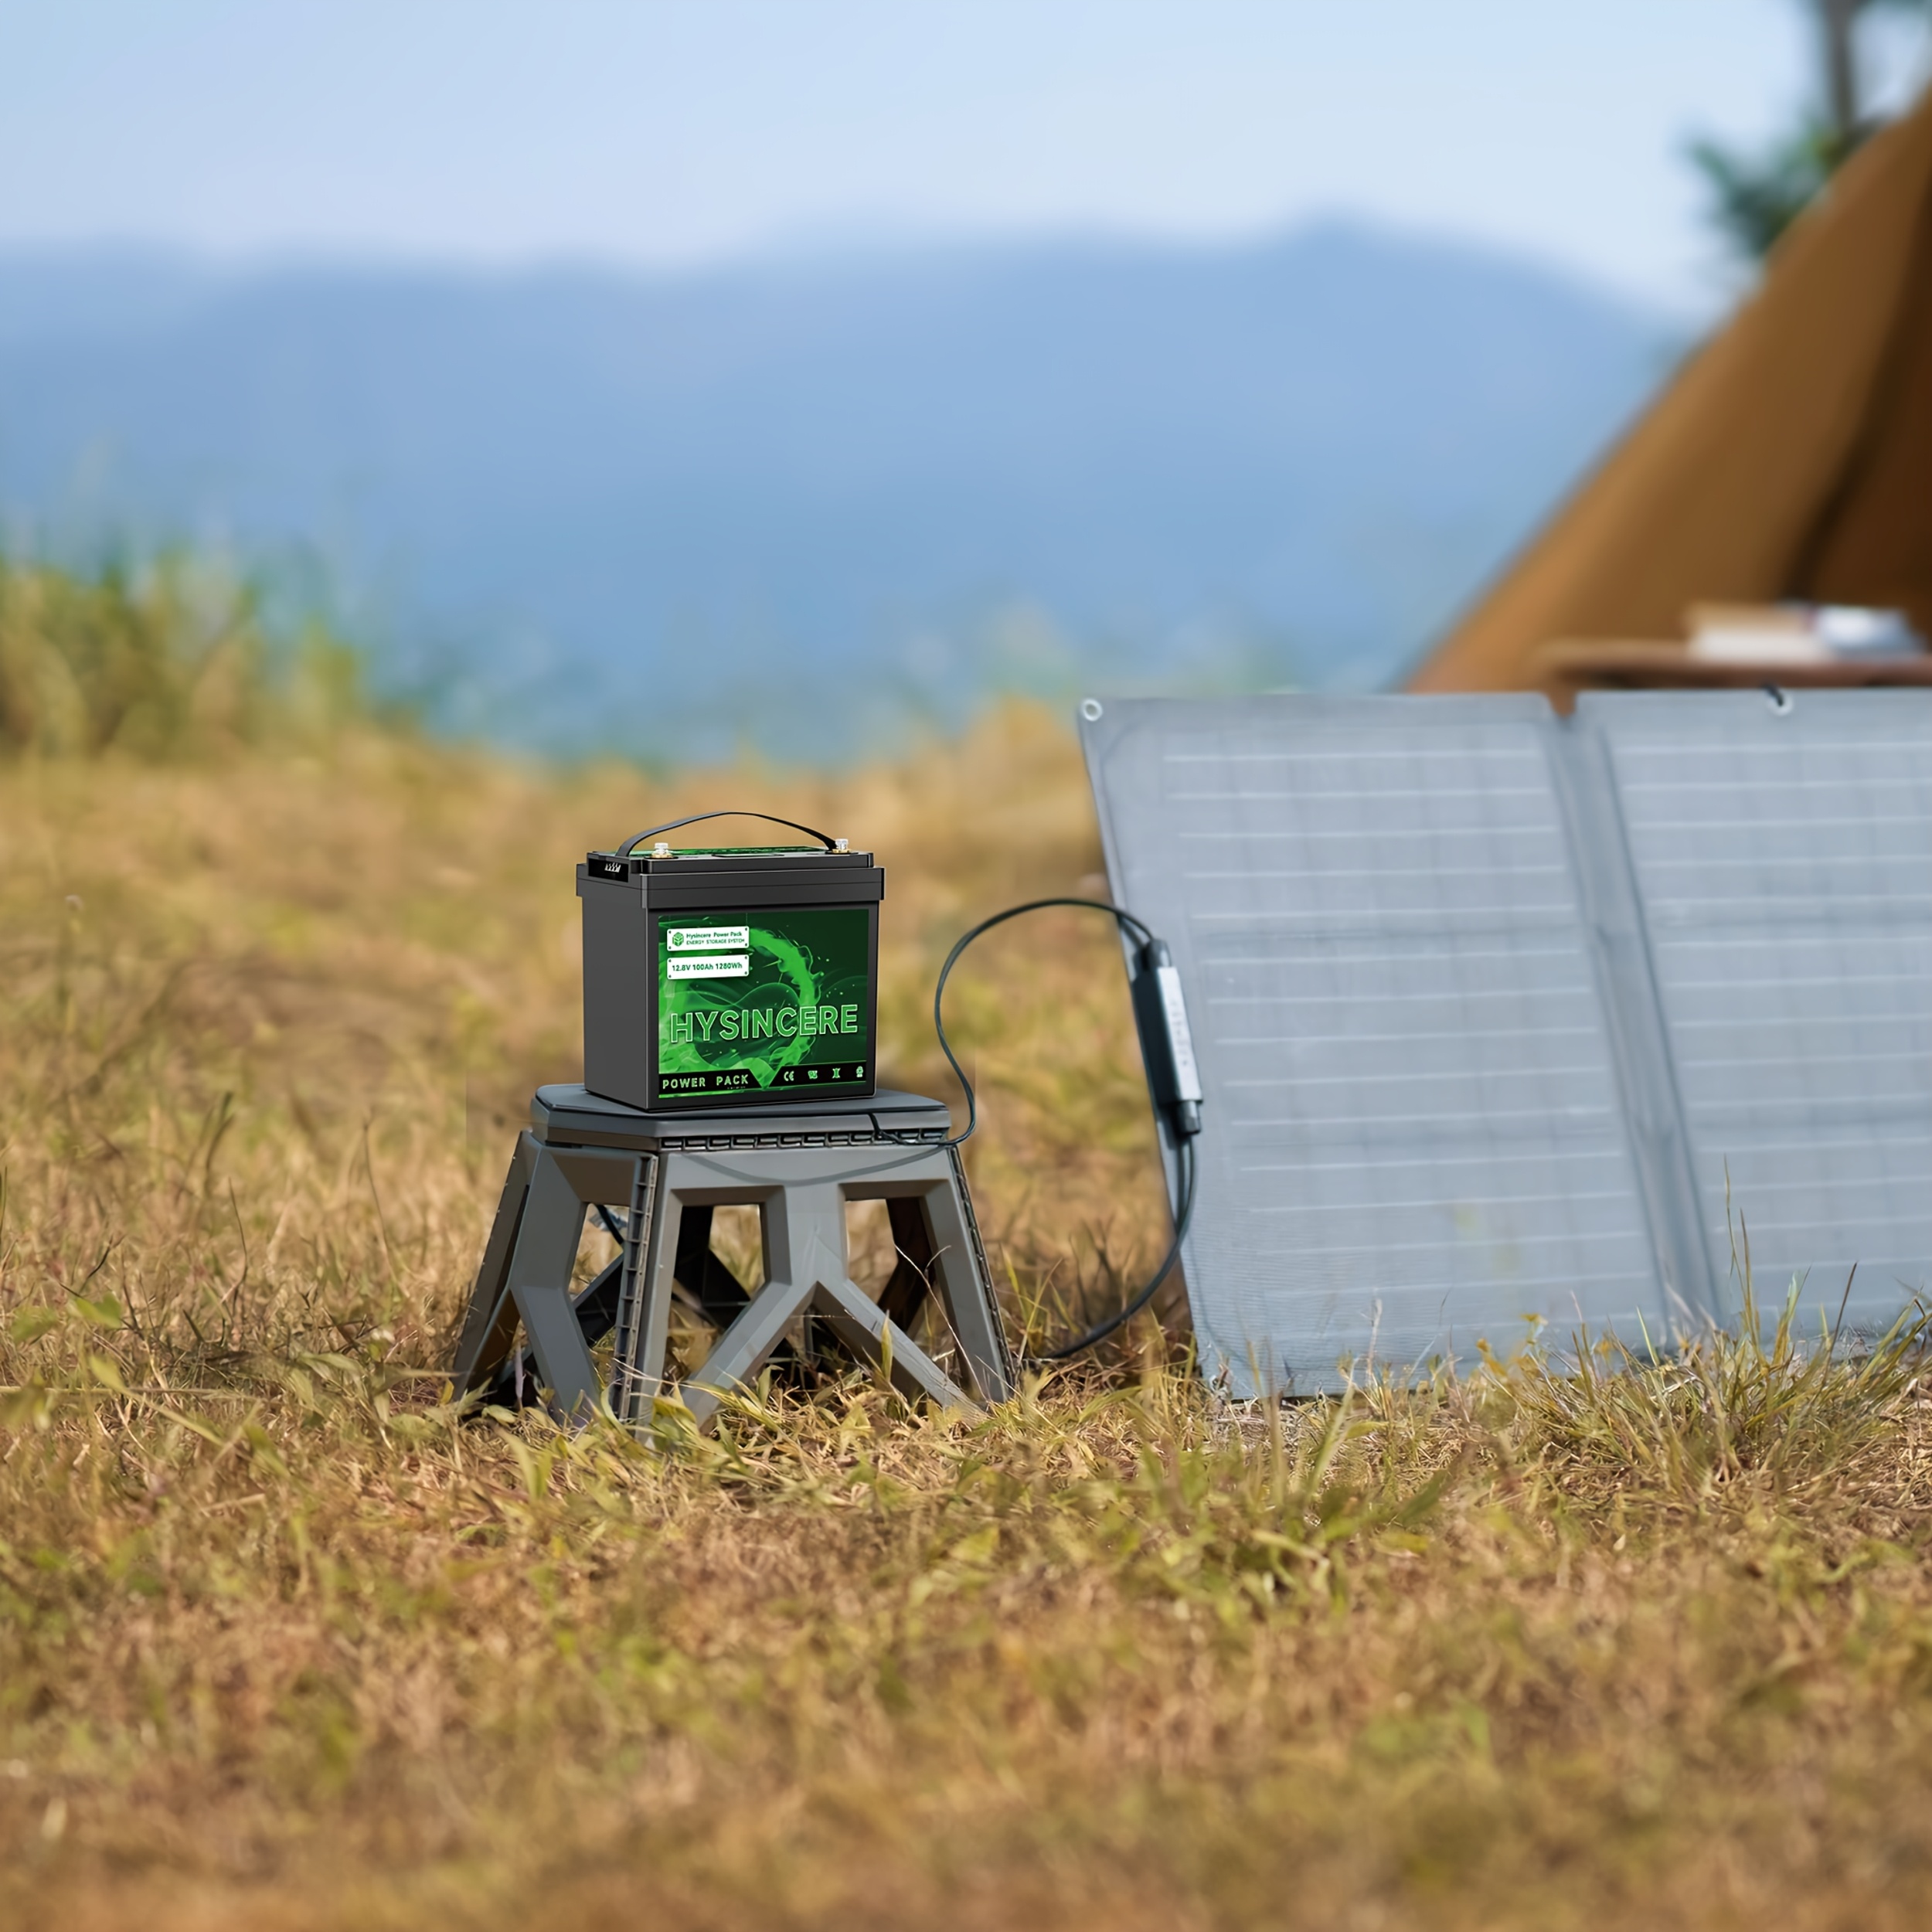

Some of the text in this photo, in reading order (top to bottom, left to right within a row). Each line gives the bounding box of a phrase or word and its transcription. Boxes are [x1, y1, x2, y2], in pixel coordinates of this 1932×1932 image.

[670, 1004, 859, 1043] HYSINCERE
[662, 1074, 749, 1090] POWER PACK
